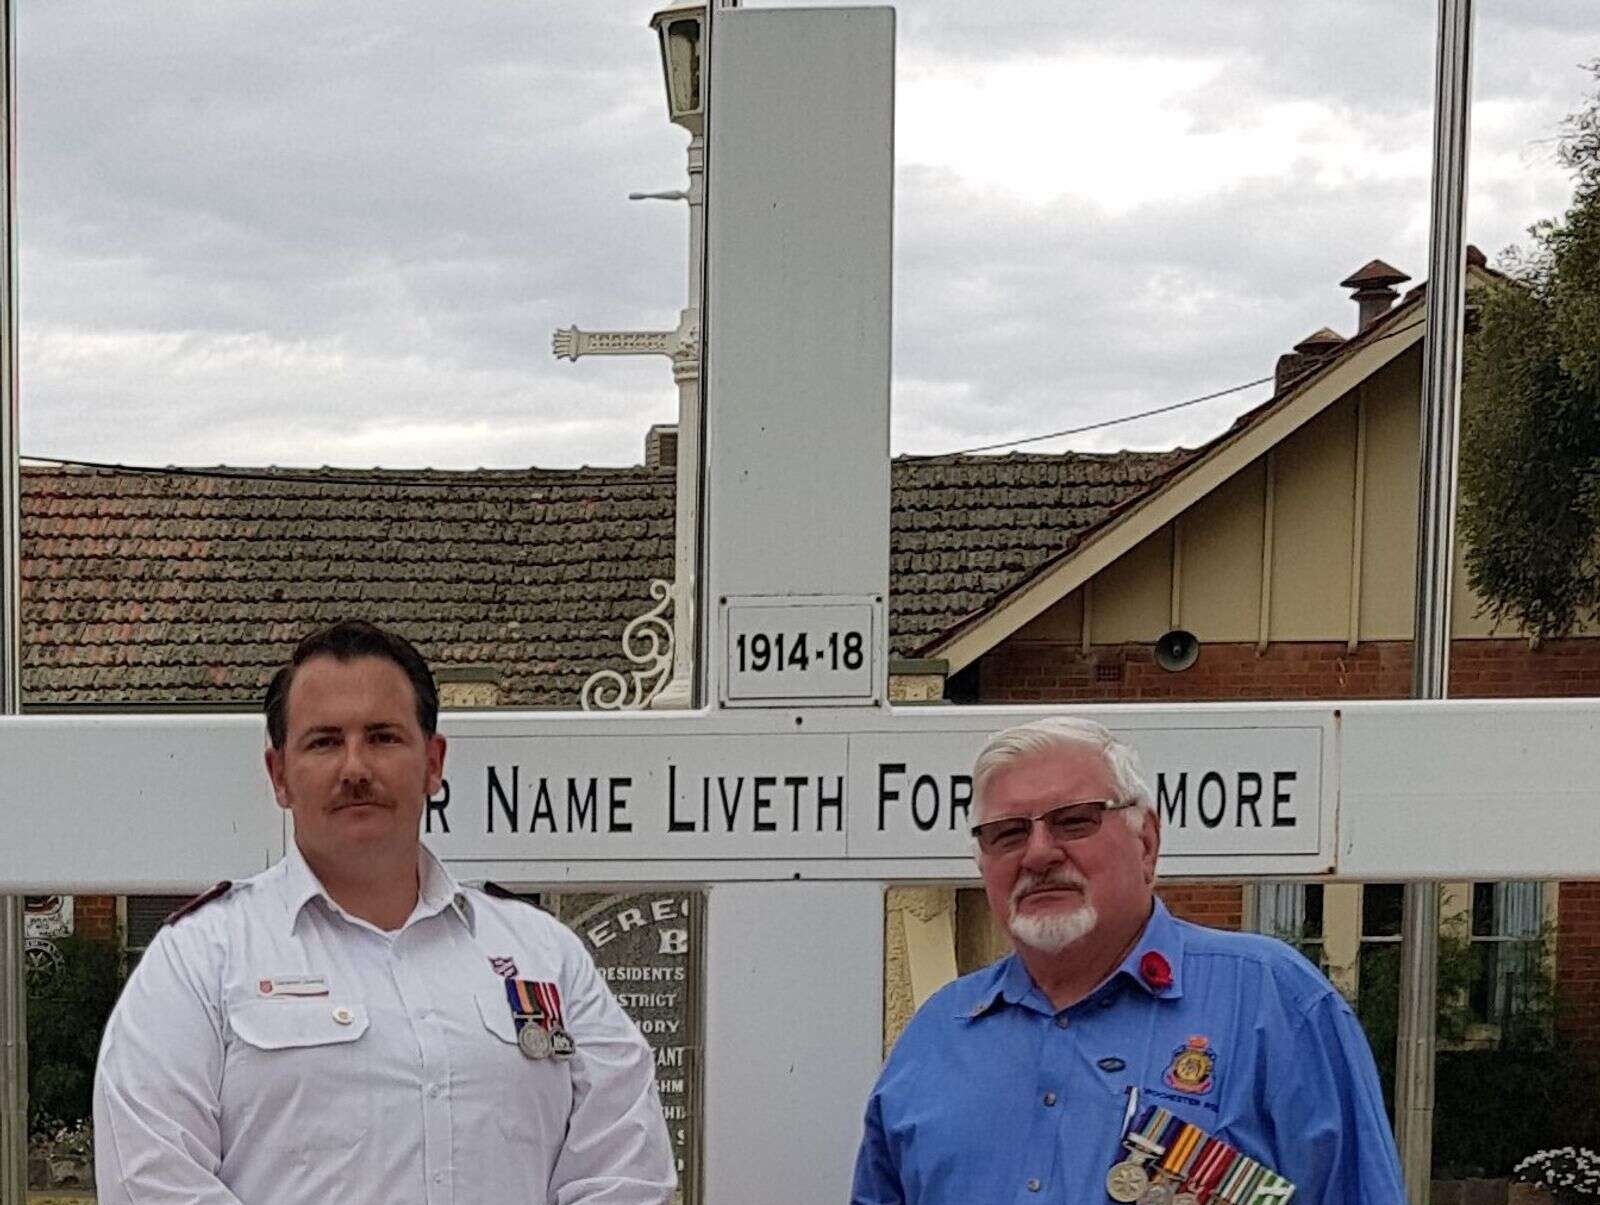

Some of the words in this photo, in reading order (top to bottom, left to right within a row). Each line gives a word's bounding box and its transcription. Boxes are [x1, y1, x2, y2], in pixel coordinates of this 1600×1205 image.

[736, 631, 864, 674] 1914-18
[486, 765, 633, 834] NAME
[667, 764, 845, 834] LIVETH
[615, 993, 677, 1007] STRICT
[651, 1046, 685, 1067] ANT
